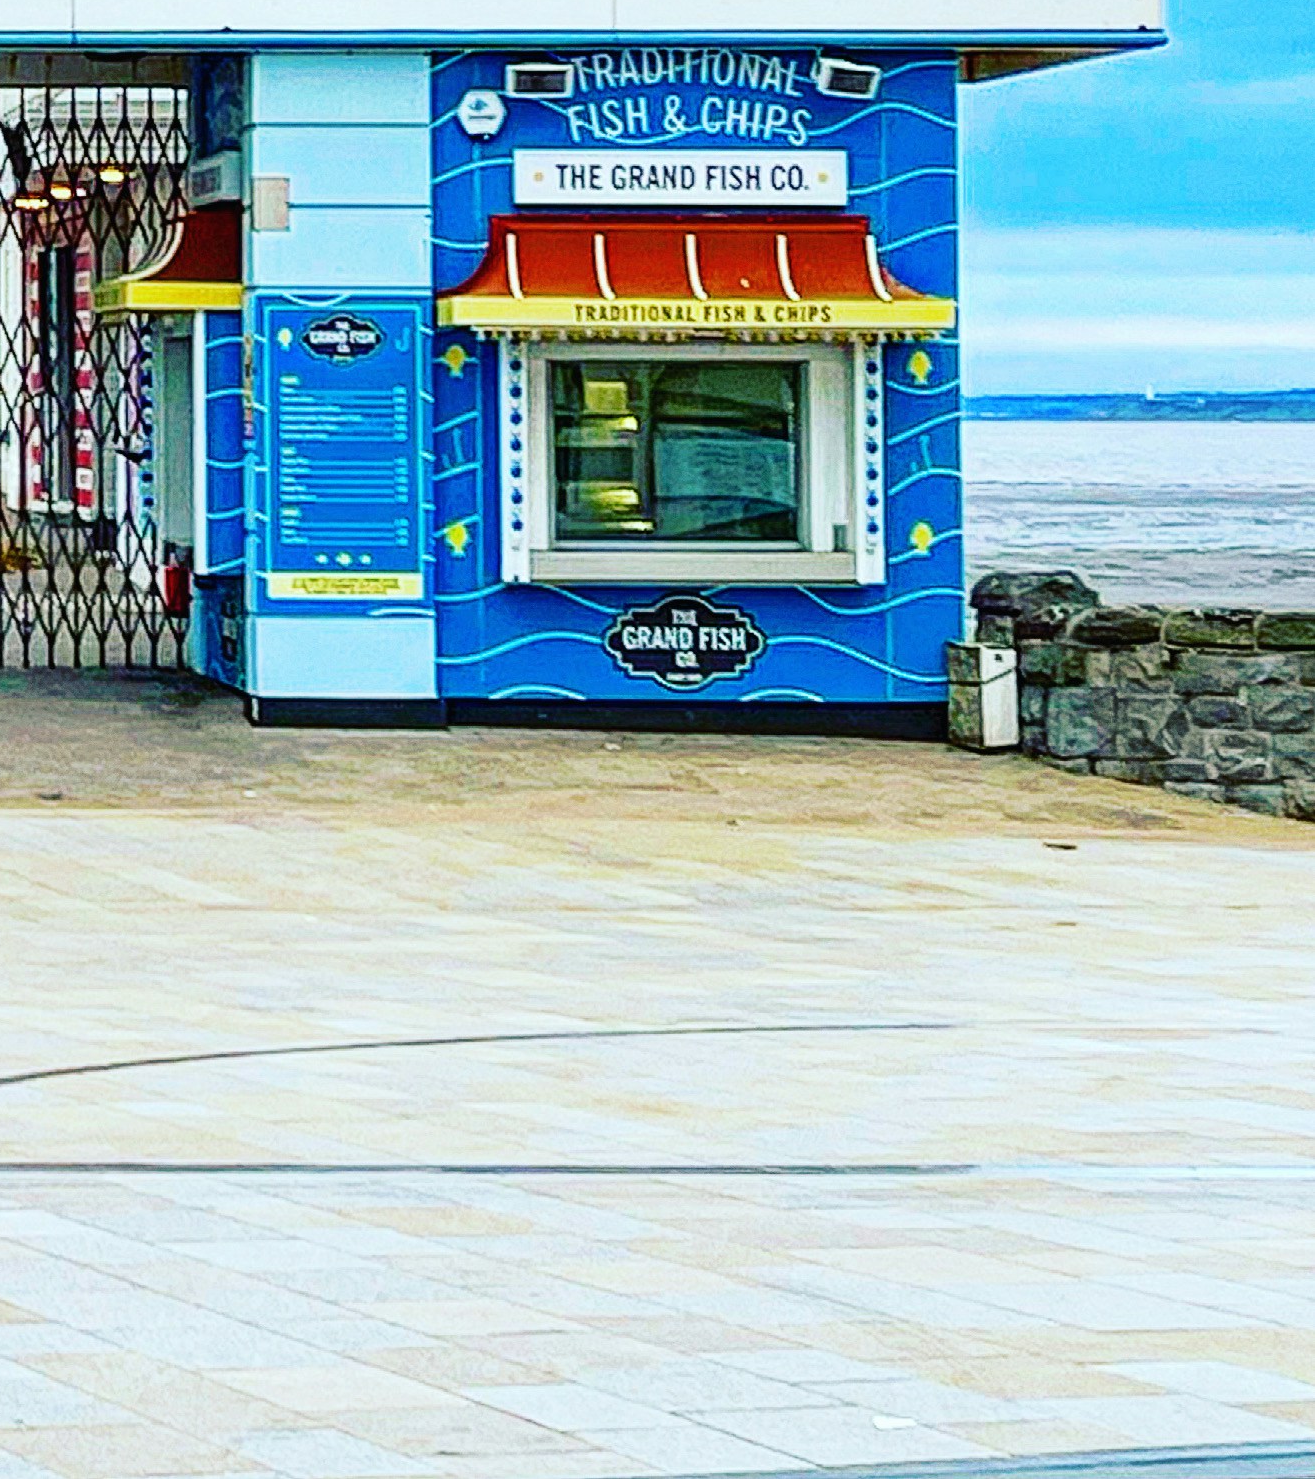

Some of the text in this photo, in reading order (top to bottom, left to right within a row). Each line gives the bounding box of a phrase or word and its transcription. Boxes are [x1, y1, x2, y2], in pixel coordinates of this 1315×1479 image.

[570, 48, 804, 97] TRADITIONAL
[567, 94, 813, 147] FISH & CHIPS
[555, 163, 810, 192] THE GRAND FISH CO.
[574, 304, 833, 323] TRADITIONAL FISH & CHIPS
[621, 626, 747, 652] GRAND FISH
